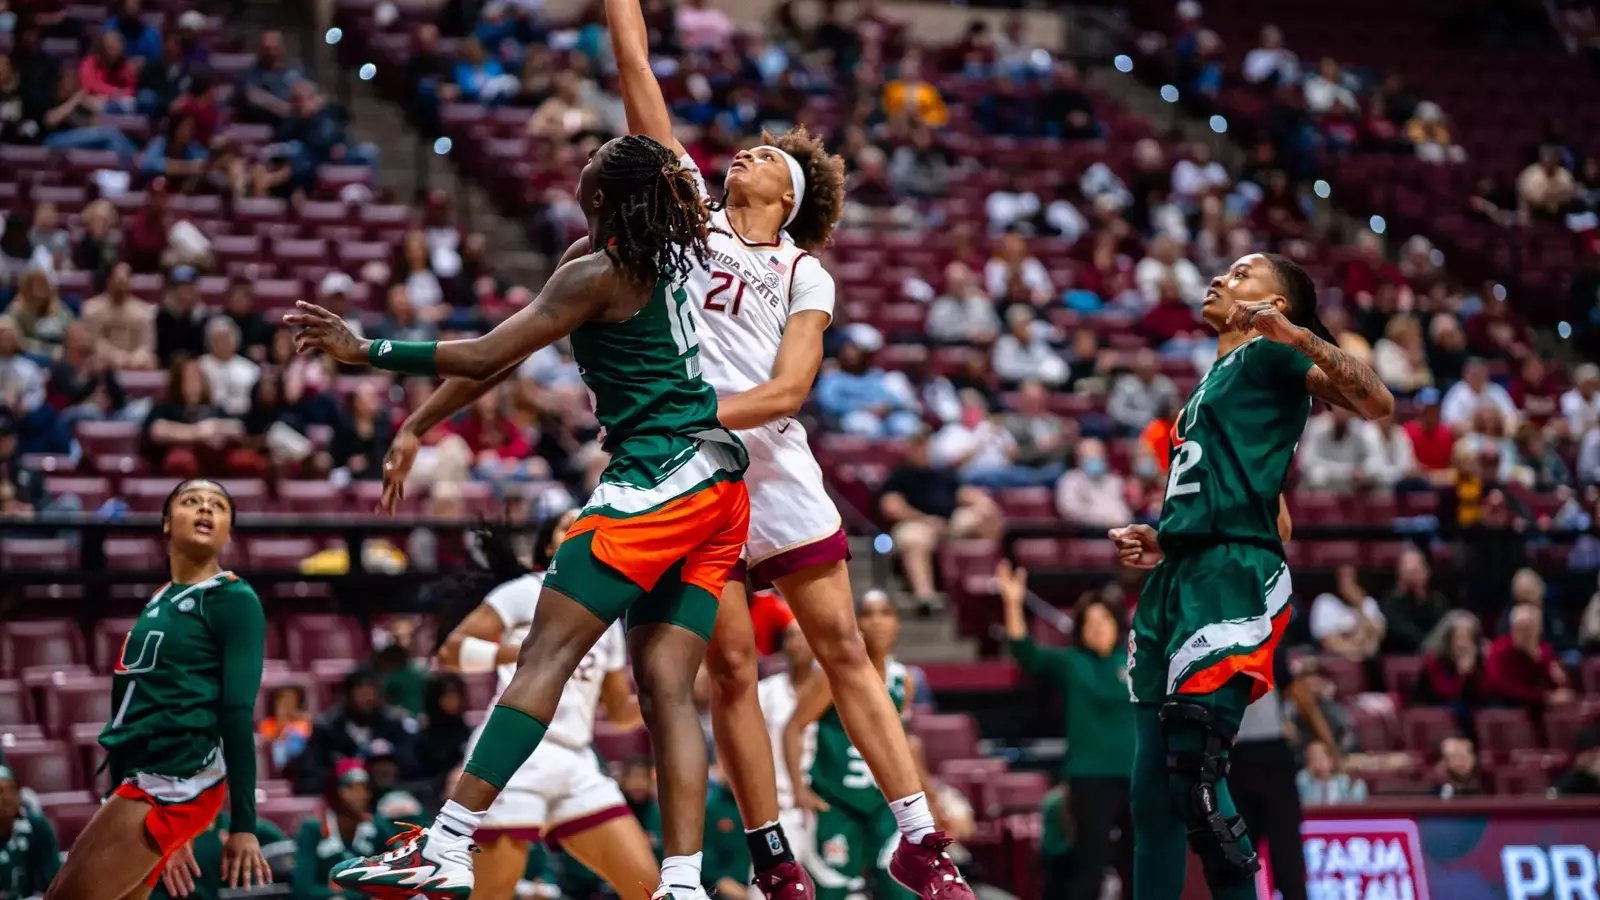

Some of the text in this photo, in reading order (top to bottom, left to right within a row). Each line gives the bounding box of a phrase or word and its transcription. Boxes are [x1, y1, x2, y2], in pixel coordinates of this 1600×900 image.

[703, 271, 746, 316] 21
[743, 269, 779, 308] STATE
[114, 630, 164, 675] U
[1303, 836, 1409, 874] FARM
[1500, 845, 1600, 900] PR
